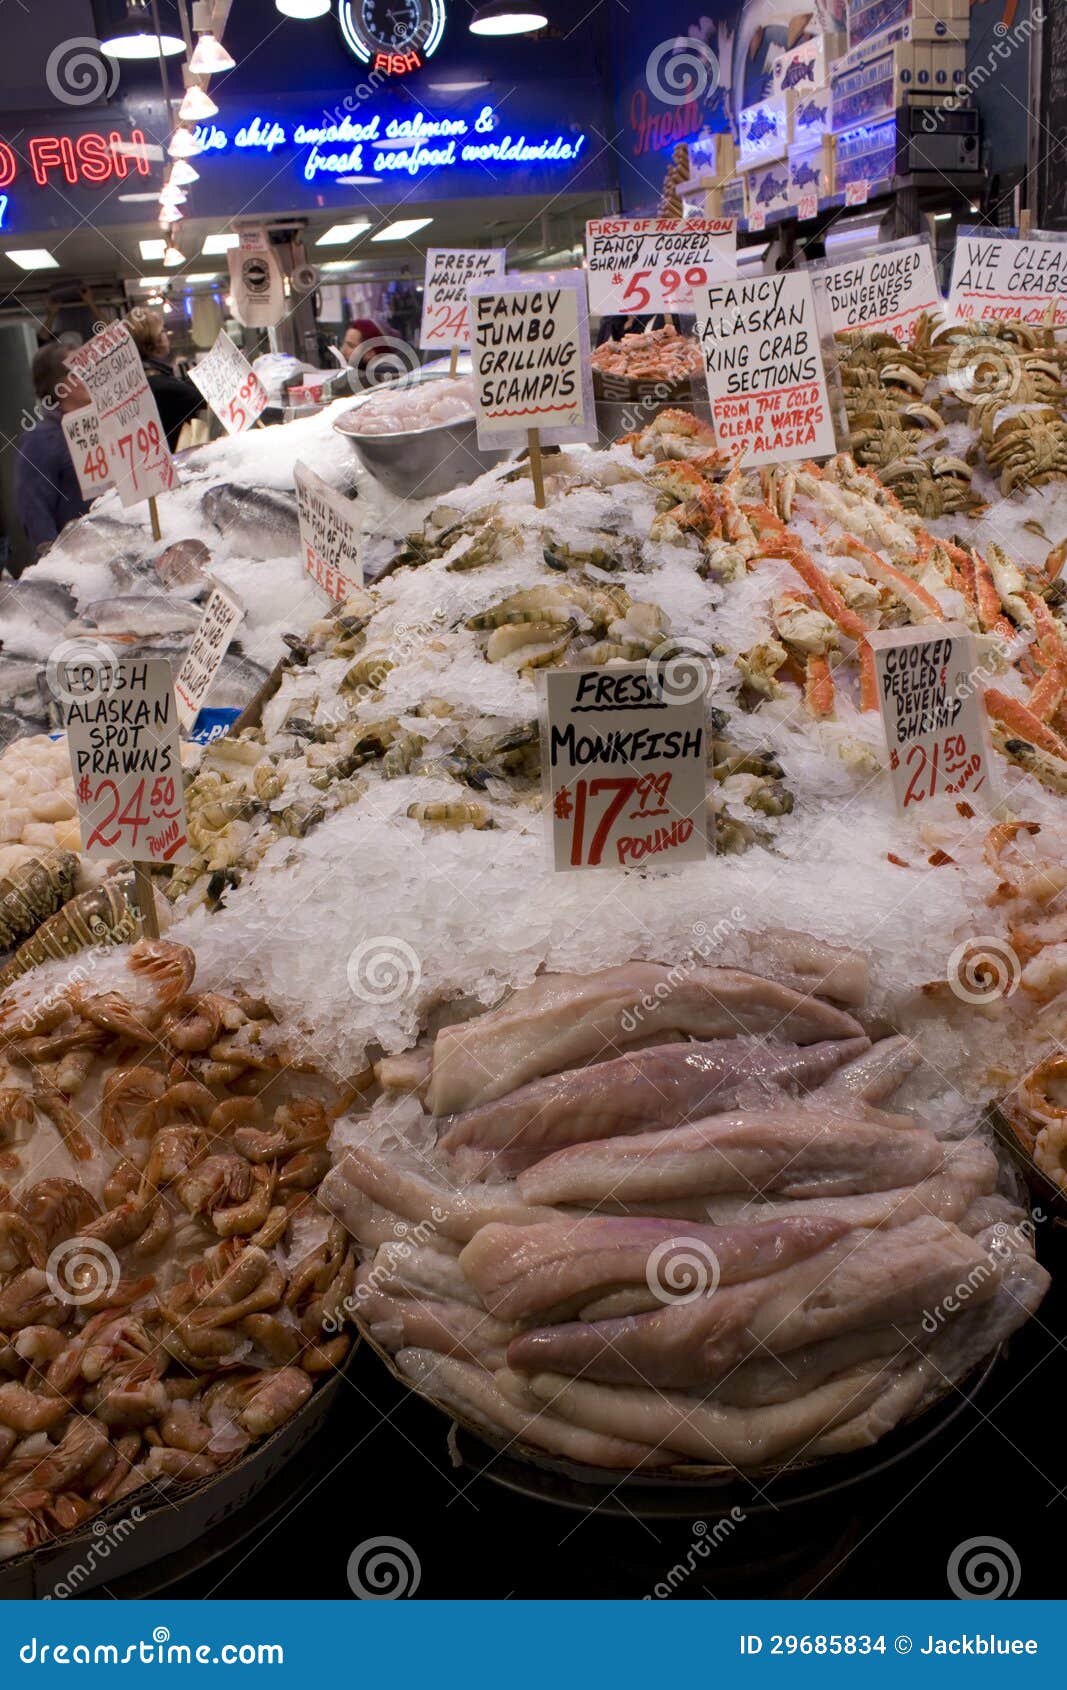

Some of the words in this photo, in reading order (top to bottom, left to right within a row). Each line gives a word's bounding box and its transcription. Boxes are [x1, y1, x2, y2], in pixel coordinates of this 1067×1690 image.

[375, 51, 421, 74] FISH
[193, 124, 228, 151] We
[234, 116, 286, 152] ship
[293, 114, 380, 145] smoked
[385, 112, 468, 138] salmon
[475, 106, 494, 133] &
[29, 129, 150, 186] FISH
[304, 143, 363, 180] fresh
[373, 140, 456, 175] seafood
[461, 134, 585, 161] worldwide!
[588, 220, 628, 236] FIRST
[633, 220, 651, 232] OF
[655, 219, 678, 231] THE
[682, 218, 733, 232] SEASON
[435, 254, 491, 269] FRESH
[590, 253, 639, 271] SHRIMP
[643, 253, 659, 267] IN
[664, 249, 714, 267] SHELL
[593, 238, 644, 256] FANCY
[655, 234, 710, 251] COOKED
[968, 243, 1001, 268] WE
[1013, 246, 1067, 272] CLEA
[811, 268, 864, 297] FRESH
[870, 252, 921, 281] COOKED
[956, 270, 996, 291] ALL
[477, 289, 561, 321] FANCY
[708, 275, 786, 310] FANCY
[831, 272, 913, 312] DUNGENESS
[701, 298, 805, 342] ALASKAN
[847, 295, 899, 325] CRABS
[955, 303, 974, 319] NO
[981, 303, 1022, 319] EXTRA
[476, 318, 555, 347] JUMBO
[479, 341, 576, 375] GRILLING
[705, 345, 749, 373] KING
[759, 331, 808, 362] CRAB
[727, 357, 817, 394] SECTIONS
[713, 402, 749, 421] FROM
[756, 395, 781, 413] THE
[786, 388, 820, 408] COLD
[719, 415, 764, 438] CLEAR
[771, 405, 824, 430] WATERS
[754, 425, 816, 453] ALASKA
[83, 446, 109, 482] 48
[306, 547, 346, 602] FREE
[886, 638, 952, 674] COOKED
[64, 663, 148, 692] FRESH
[576, 671, 664, 704] FRESH
[883, 664, 937, 701] PEELED
[67, 692, 169, 725] ALASKAN
[897, 685, 947, 716] DEVEIN
[89, 725, 144, 749] SPOT
[897, 699, 963, 743] SHRIMP
[77, 745, 172, 775] PRAWNS
[551, 723, 702, 766] MONKFISH
[616, 818, 694, 865] POUND
